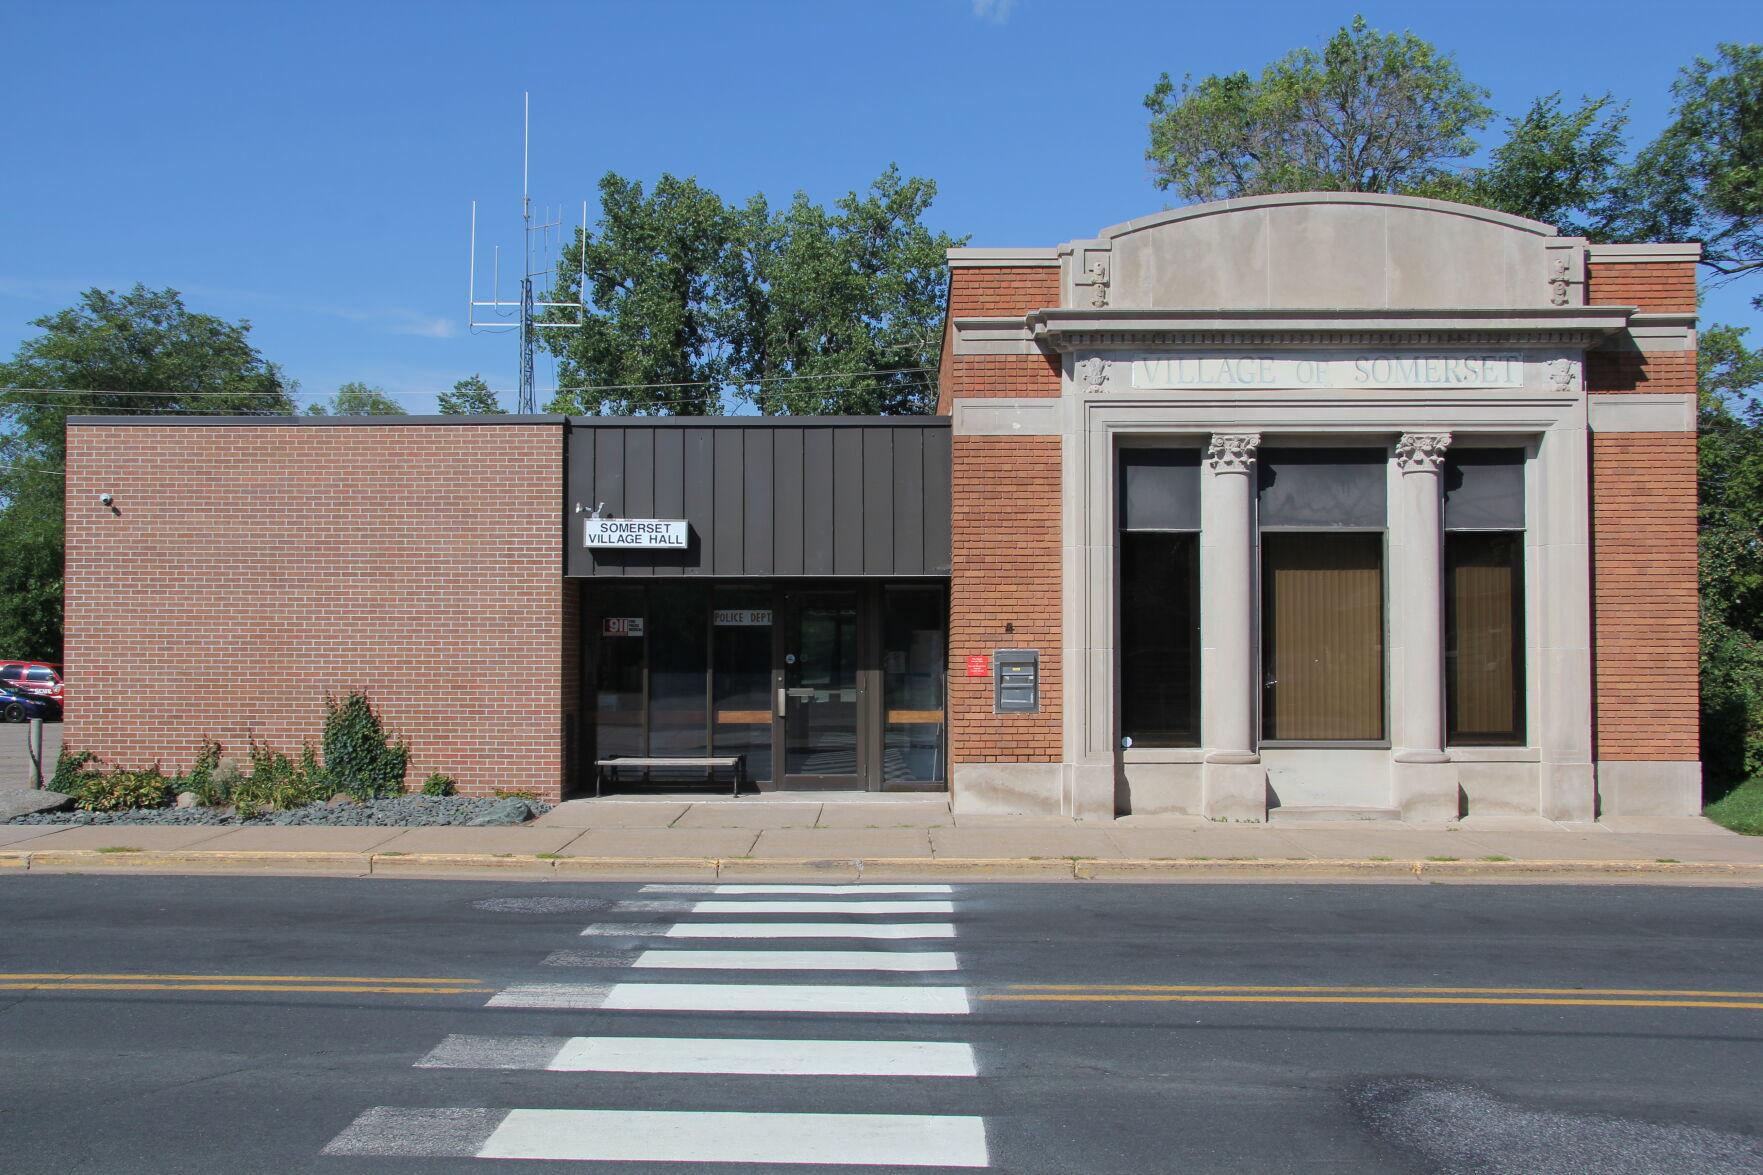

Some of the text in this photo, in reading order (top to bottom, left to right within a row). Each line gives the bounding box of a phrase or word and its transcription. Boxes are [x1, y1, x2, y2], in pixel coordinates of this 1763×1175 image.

[1142, 356, 1519, 384] VILLAGE OF SOMERSET
[600, 523, 671, 533] SOMERSET
[589, 534, 683, 545] VILLAGE HALL
[714, 612, 771, 623] POLICE DEPT
[608, 619, 627, 632] 911
